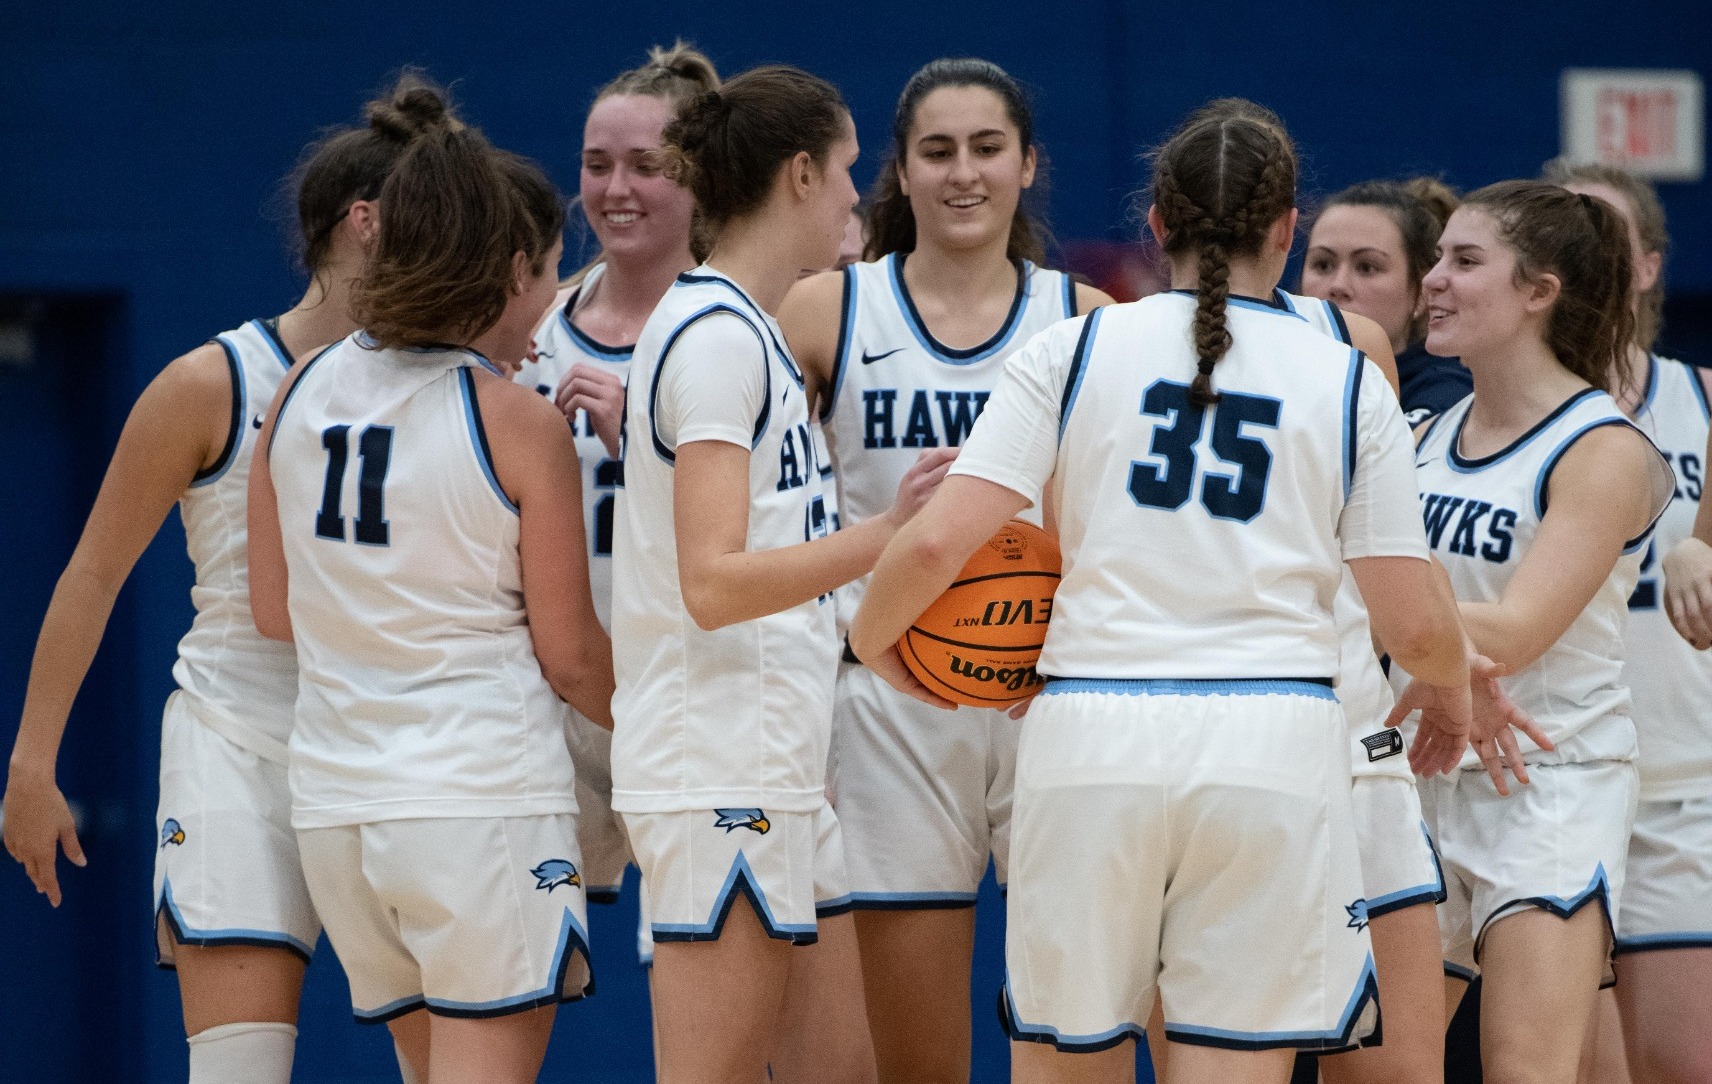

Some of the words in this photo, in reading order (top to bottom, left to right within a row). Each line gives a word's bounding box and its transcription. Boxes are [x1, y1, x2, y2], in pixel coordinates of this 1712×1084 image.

[315, 423, 395, 547] 11
[1126, 378, 1284, 525] 35
[1419, 491, 1518, 565] WKS
[953, 617, 981, 628] NXT
[950, 655, 1046, 691] ilson
